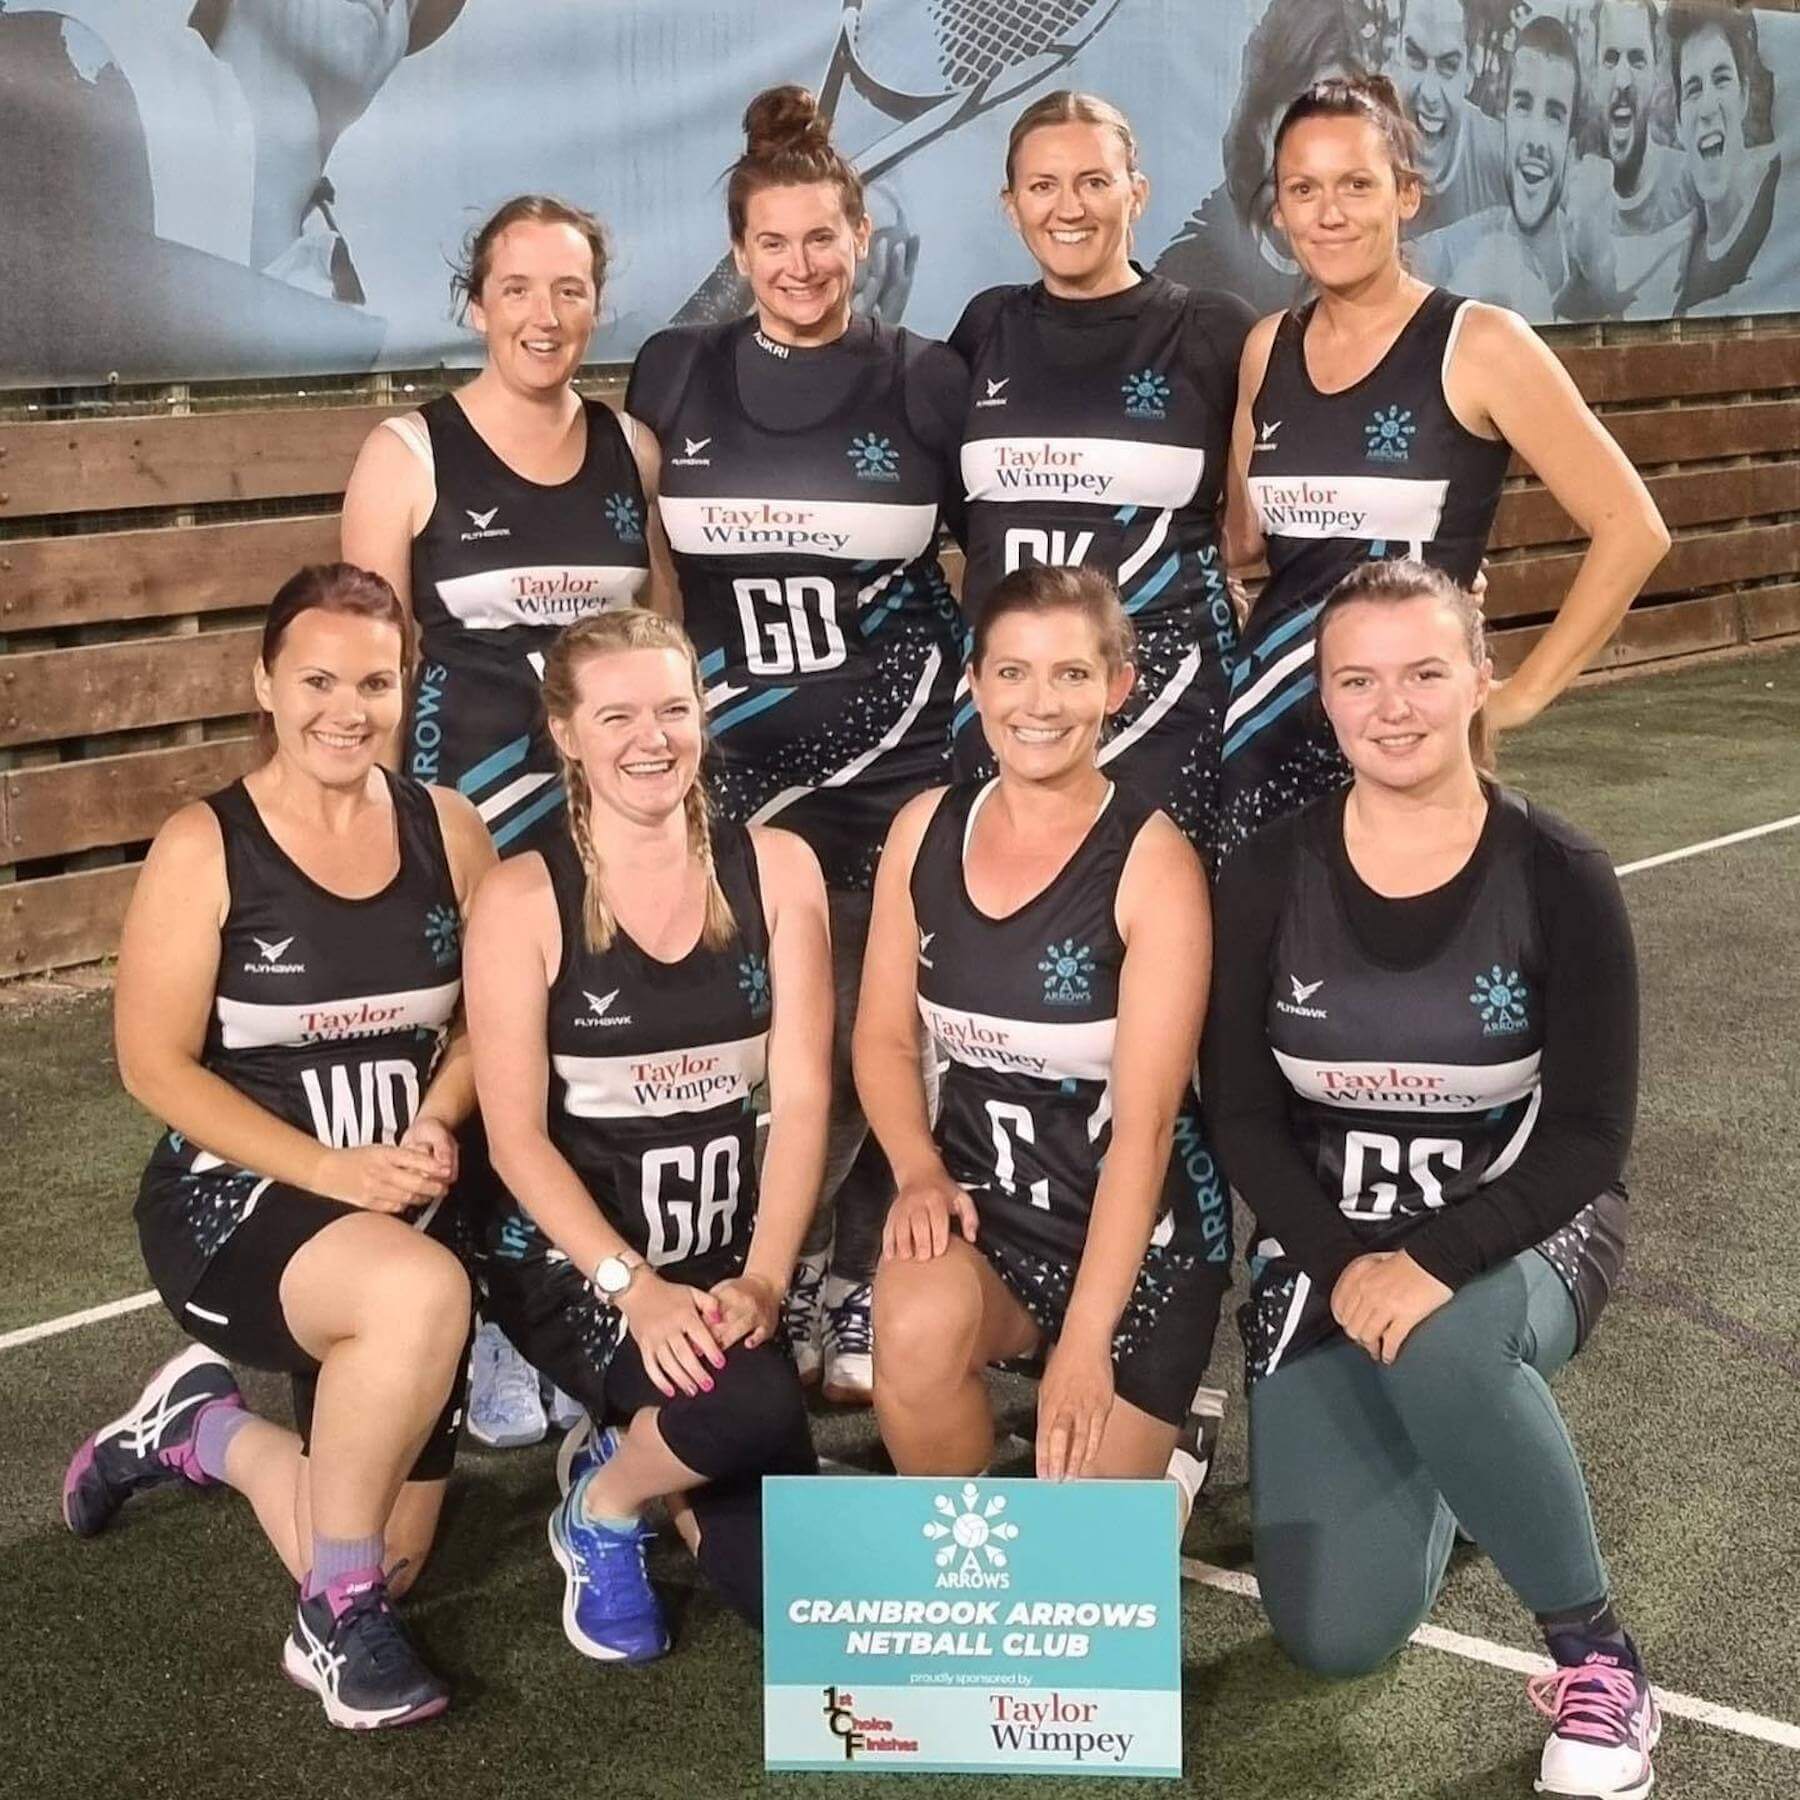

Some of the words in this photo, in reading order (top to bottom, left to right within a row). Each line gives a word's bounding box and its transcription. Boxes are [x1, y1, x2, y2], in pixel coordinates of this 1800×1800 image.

[995, 444, 1083, 471] Taylor
[996, 468, 1114, 496] Wimpey
[1258, 482, 1338, 505] Taylor
[700, 505, 813, 528] Taylor
[1263, 506, 1367, 531] Wimpey
[702, 527, 850, 551] Wimpey
[511, 572, 598, 596] Taylor
[733, 576, 848, 675] GD
[413, 664, 449, 786] ROWS
[300, 1003, 404, 1031] Taylor
[929, 1011, 1009, 1046] Taylor
[630, 1054, 719, 1083] Taylor
[1316, 1068, 1446, 1091] Taylor
[632, 1072, 743, 1105] Wimpey
[1323, 1088, 1483, 1108] Wimpey
[300, 1059, 420, 1149] WD
[1174, 1116, 1227, 1262] ARROW
[1338, 1130, 1464, 1221] GS
[641, 1135, 741, 1268] GA
[934, 1572, 1011, 1589] ARROWS
[787, 1599, 1000, 1626] CRANBROOK
[1003, 1602, 1158, 1628] ARROWS
[845, 1631, 993, 1657] NETBALL
[1002, 1633, 1090, 1658] CLUB
[910, 1673, 954, 1685] proudly
[1018, 1673, 1033, 1687] by
[990, 1692, 1098, 1730] Taylor
[990, 1723, 1134, 1762] Wimpey
